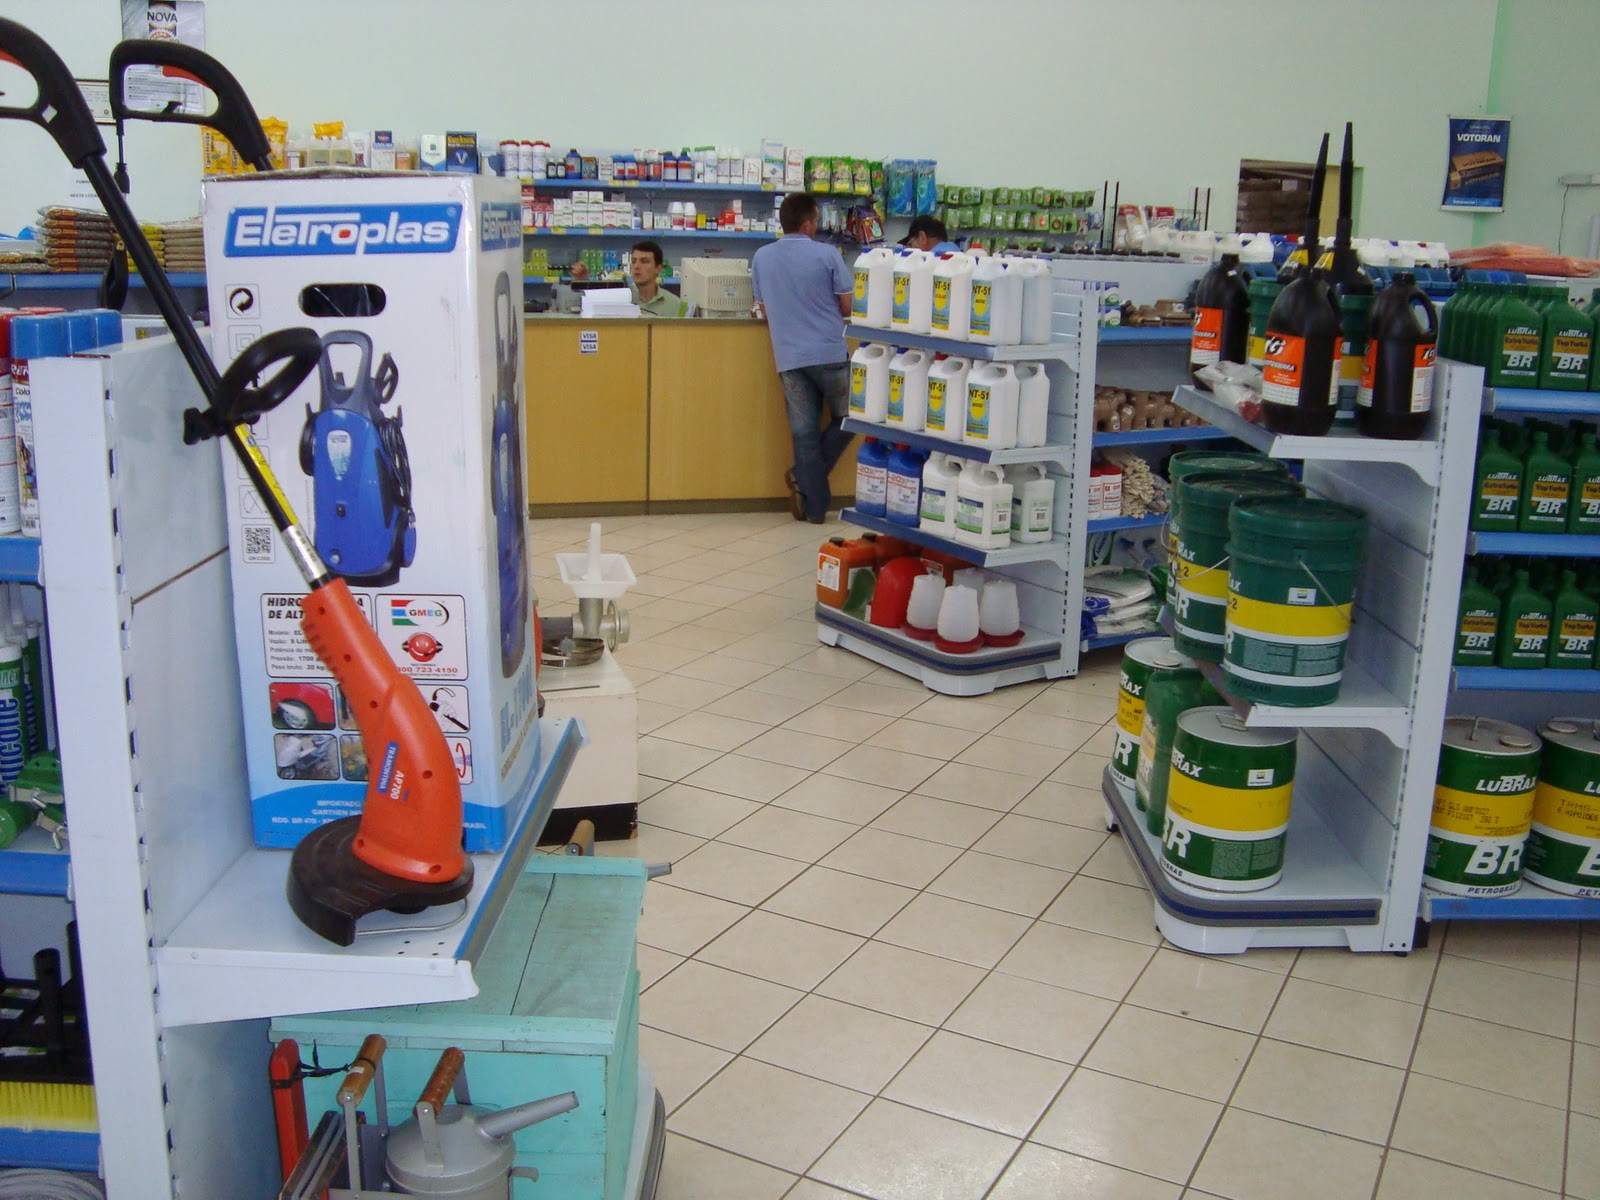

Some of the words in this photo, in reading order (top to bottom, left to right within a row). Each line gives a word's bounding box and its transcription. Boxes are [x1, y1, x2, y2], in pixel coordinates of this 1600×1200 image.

[147, 11, 178, 23] NOVA
[1457, 133, 1502, 143] VOTORAN
[854, 272, 869, 282] NT-51
[894, 276, 910, 286] NT-51
[933, 281, 951, 291] NT-51
[972, 285, 992, 296] NT-51
[1507, 354, 1533, 368] BR
[1557, 356, 1584, 371] BR
[852, 367, 867, 378] NT-51
[889, 374, 904, 385] NT-51
[929, 381, 946, 393] NT-51
[968, 388, 990, 400] NT-51
[1486, 499, 1512, 512] BR
[1536, 501, 1561, 514] BR
[268, 611, 282, 619] DE
[285, 611, 304, 619] ALT
[409, 609, 443, 617] GMEG
[1465, 634, 1490, 648] BR
[1519, 637, 1543, 650] BR
[1564, 638, 1589, 651] BR
[379, 746, 397, 789] TRAMONTINA
[390, 770, 405, 800] AP700
[1476, 774, 1538, 793] LUBRAX
[1464, 841, 1526, 875] BR
[1467, 883, 1517, 894] PETROBRAS
